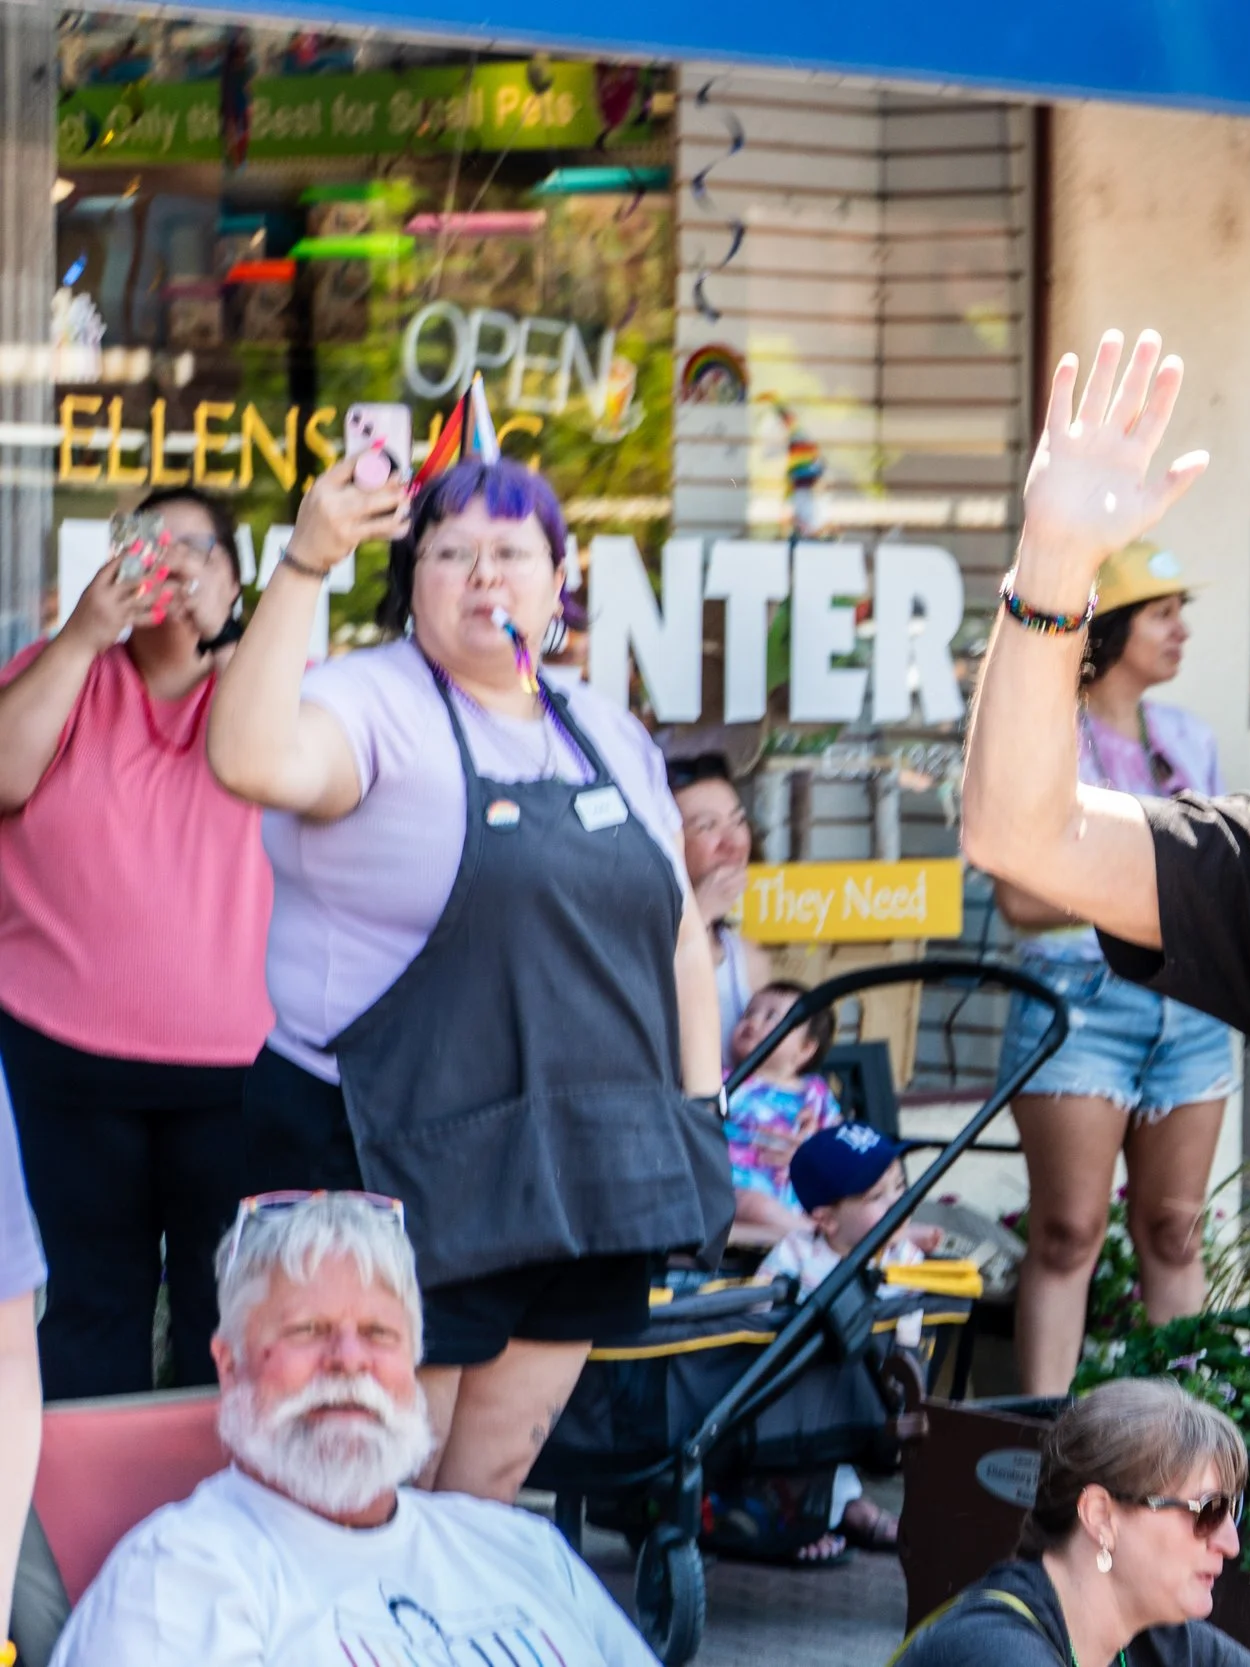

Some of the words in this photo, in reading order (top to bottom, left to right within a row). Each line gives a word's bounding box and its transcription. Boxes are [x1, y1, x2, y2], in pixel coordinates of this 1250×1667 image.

[185, 104, 222, 143] th
[330, 93, 378, 137] for
[494, 84, 576, 132] Pets
[402, 302, 616, 418] OPEN
[566, 534, 964, 724] NTER
[753, 869, 835, 939] They
[841, 868, 927, 924] Need
